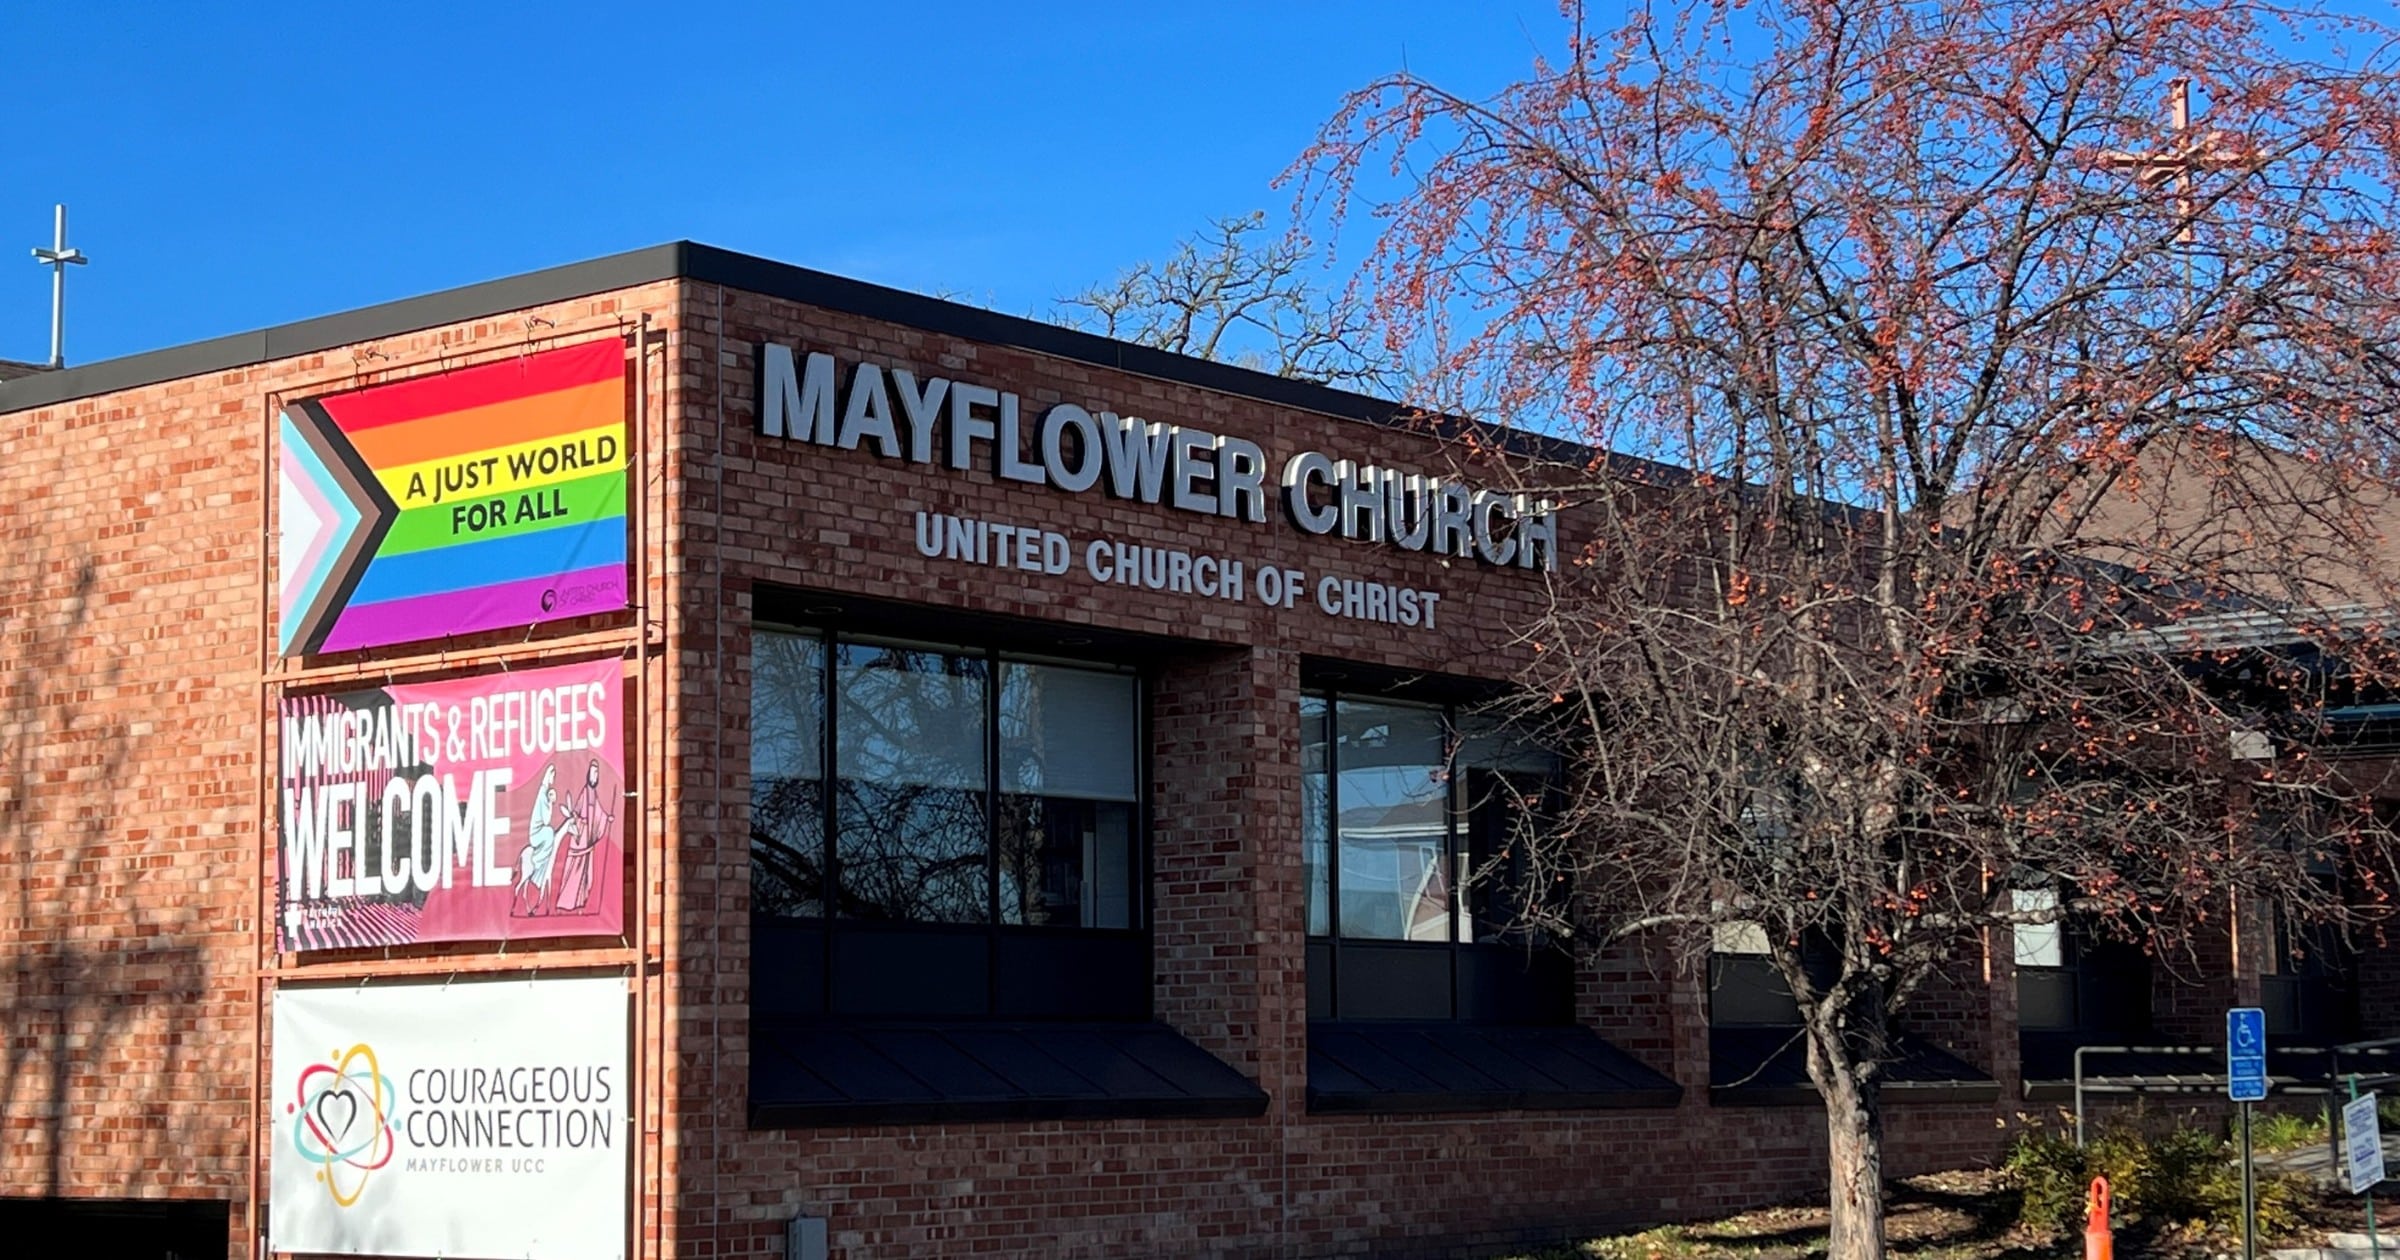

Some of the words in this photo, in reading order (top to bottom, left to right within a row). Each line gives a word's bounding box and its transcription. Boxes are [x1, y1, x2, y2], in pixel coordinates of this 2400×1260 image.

[406, 472, 426, 501] A
[433, 457, 499, 503] JUST
[507, 435, 617, 481] WORLD
[763, 342, 1267, 523] MAYFLOWER
[1281, 451, 1558, 573] CHURCH
[452, 500, 507, 535] FOR
[514, 489, 568, 525] ALL
[915, 511, 1071, 575] UNITED
[1086, 539, 1244, 601] CHURCH
[1256, 565, 1304, 609] OF
[1317, 576, 1440, 629] CHRIST
[283, 702, 441, 779] IMMIGRANTS
[446, 706, 466, 762] &
[471, 681, 606, 760] REFUGEES
[284, 767, 513, 900] WELCOME
[409, 1066, 611, 1104] COURAGEOUS
[407, 1109, 612, 1149] CONNECTION
[406, 1158, 503, 1172] MAYFLOWER
[512, 1158, 545, 1173] UCC
